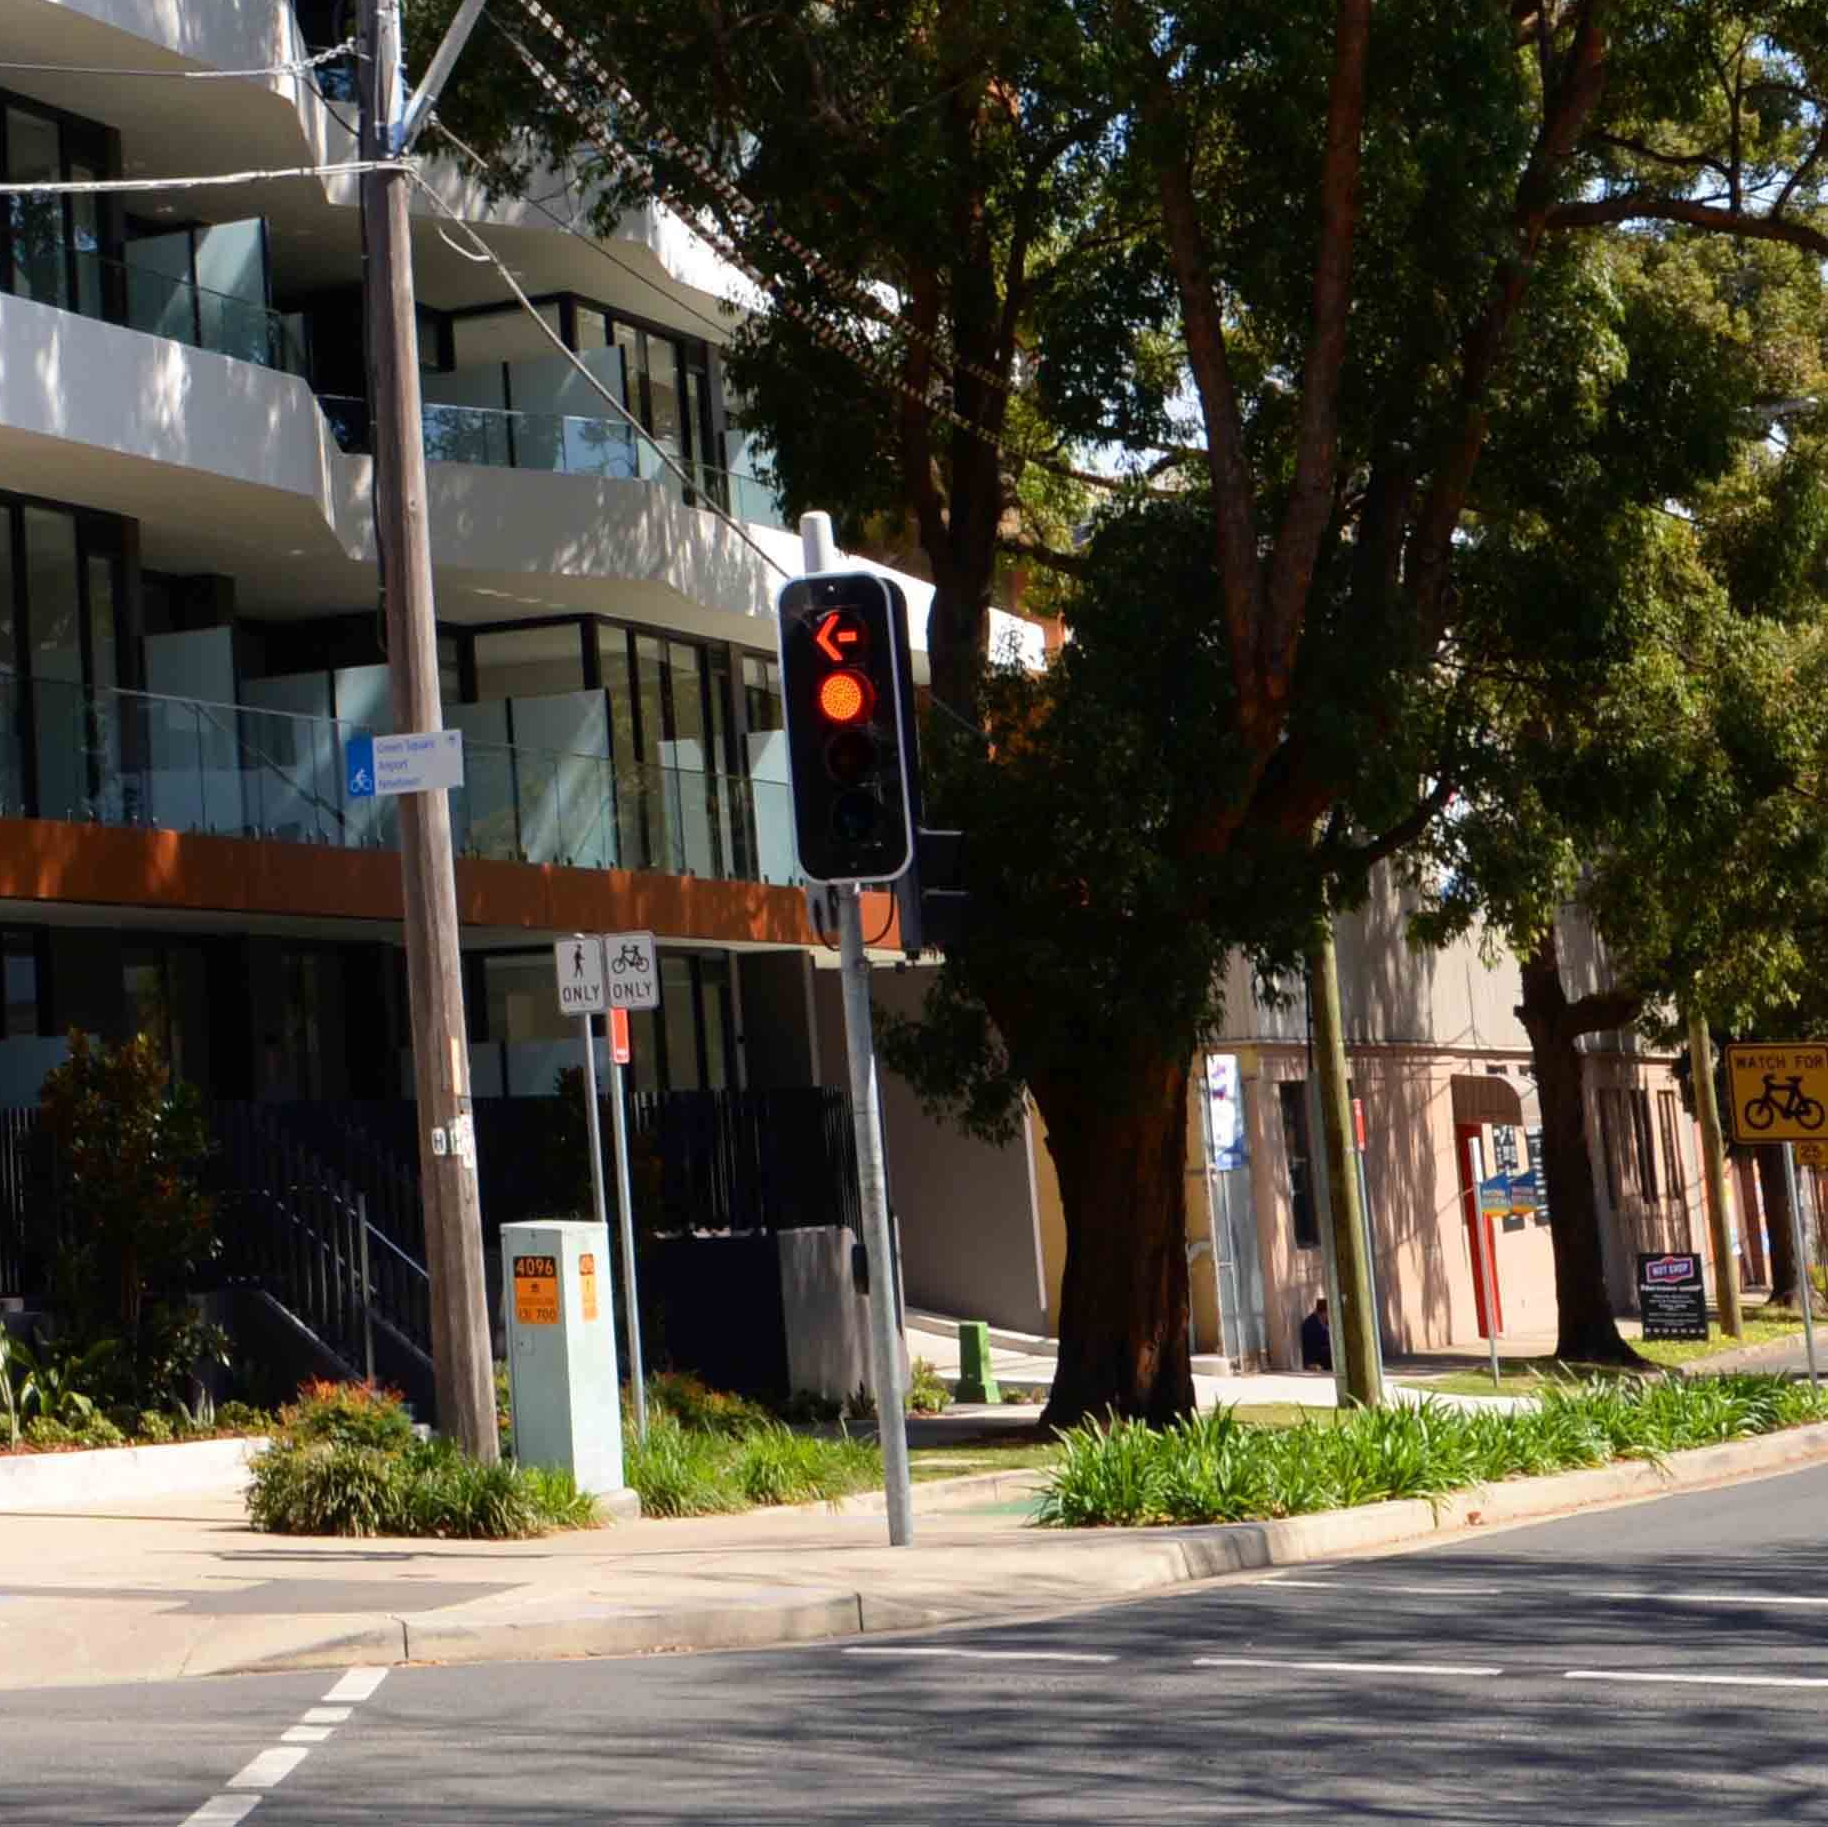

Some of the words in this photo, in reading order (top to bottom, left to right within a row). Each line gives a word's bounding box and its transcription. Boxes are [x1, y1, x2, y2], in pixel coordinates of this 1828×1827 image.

[562, 983, 601, 1003] ONLY
[612, 980, 652, 999] ONLY
[1734, 1054, 1786, 1068] WATCH
[1794, 1054, 1824, 1068] FOR
[515, 1258, 554, 1276] 4096
